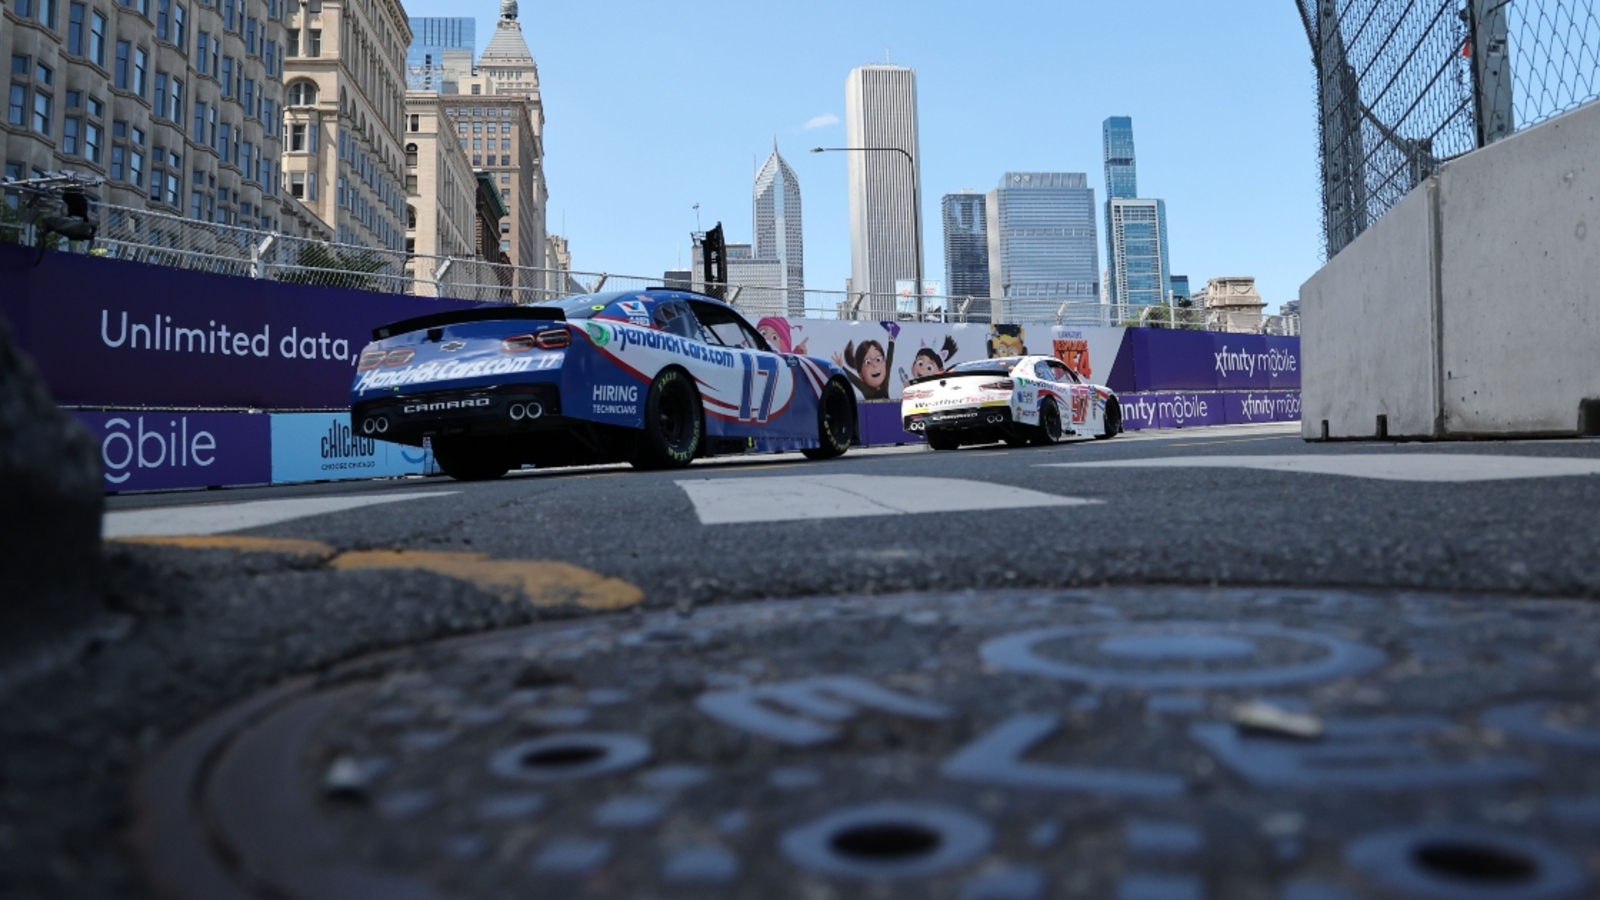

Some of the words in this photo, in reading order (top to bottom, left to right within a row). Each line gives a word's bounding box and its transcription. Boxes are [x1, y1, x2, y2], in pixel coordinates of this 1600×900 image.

[101, 309, 270, 357] Unlimited
[279, 326, 359, 366] data,
[611, 323, 735, 368] HendrickCars.com
[353, 356, 533, 396] HendrickCars.com
[537, 354, 556, 369] 17
[1214, 345, 1256, 378] xfinity
[1257, 348, 1297, 377] mobile
[592, 384, 638, 402] HIRING
[738, 352, 780, 423] 17
[914, 395, 996, 409] WeatherTech
[403, 398, 490, 414] CAMARO
[592, 403, 637, 415] TECHNICIANS
[1119, 397, 1156, 426] inity
[1159, 395, 1208, 424] mobile
[1241, 393, 1275, 421] xfinity
[102, 416, 216, 484] obile
